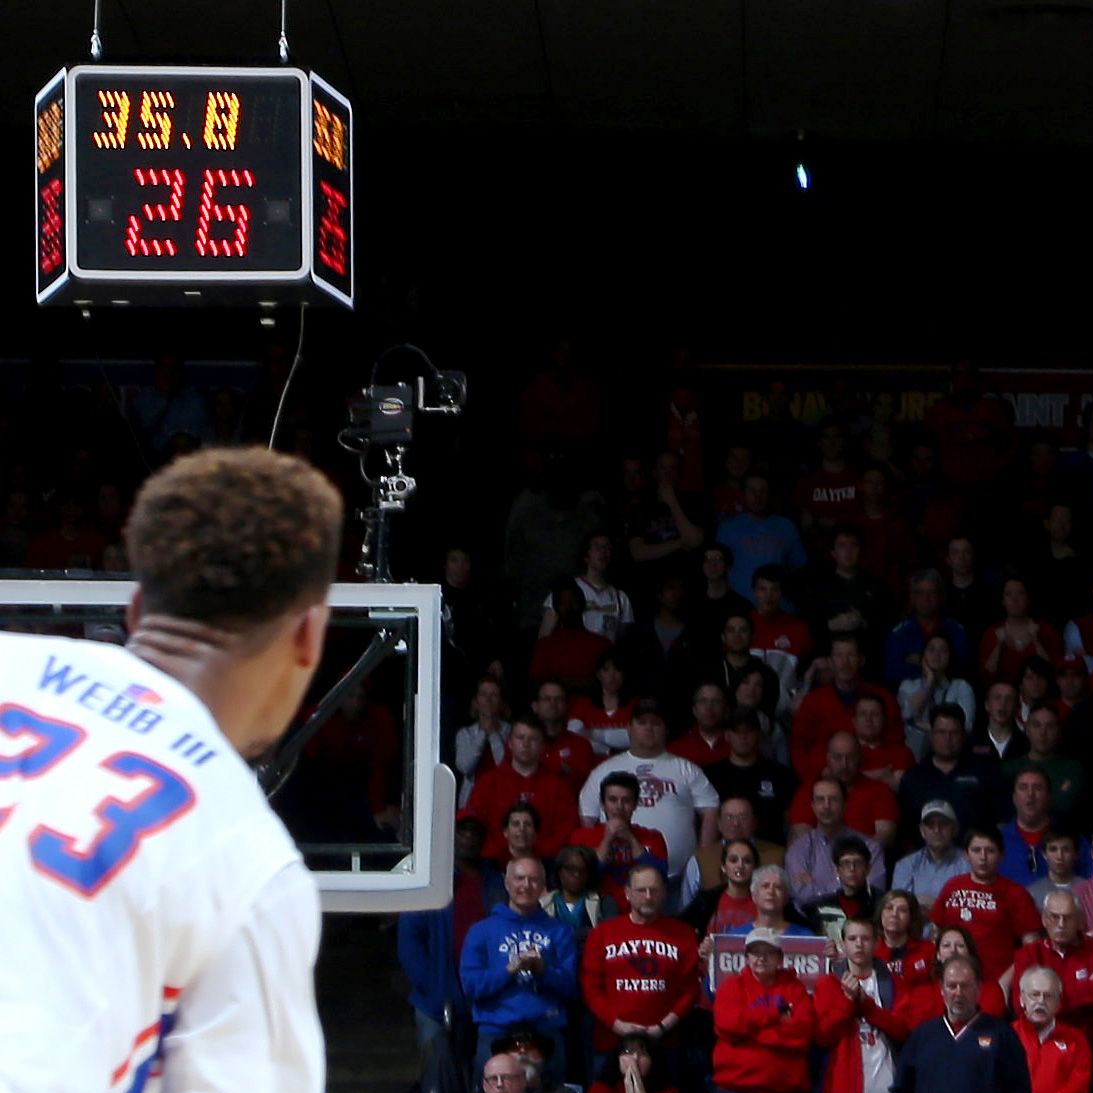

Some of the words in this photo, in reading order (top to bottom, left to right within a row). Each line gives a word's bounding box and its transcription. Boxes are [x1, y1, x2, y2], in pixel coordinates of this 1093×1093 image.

[126, 168, 256, 257] 26
[37, 655, 164, 735] WEBB
[170, 732, 218, 767] III
[605, 939, 679, 961] DAYTON
[719, 952, 746, 973] GO
[615, 978, 667, 992] FLYERS
